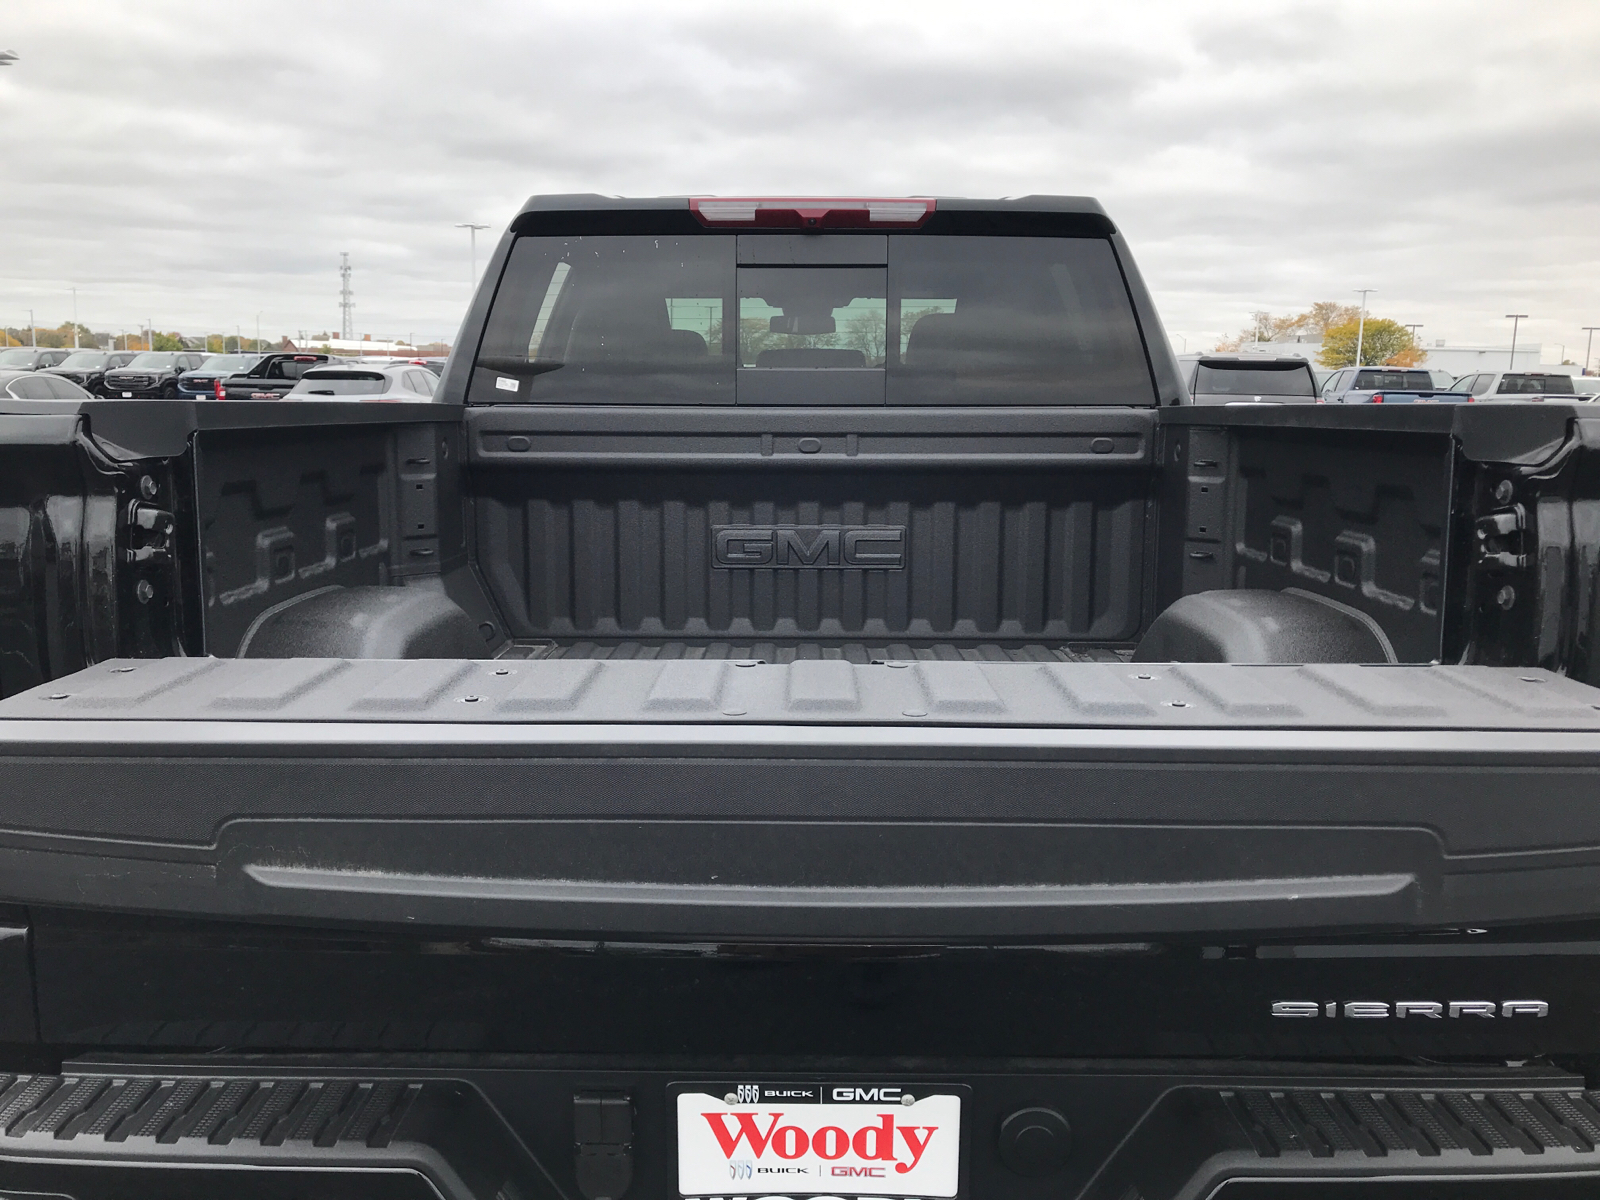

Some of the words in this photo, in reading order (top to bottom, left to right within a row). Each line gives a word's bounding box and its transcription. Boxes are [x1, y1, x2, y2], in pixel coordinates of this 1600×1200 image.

[715, 529, 902, 565] GMC
[1271, 1000, 1549, 1019] SIERRA
[764, 1089, 814, 1098] BUICK
[832, 1087, 902, 1101] GMC
[700, 1112, 939, 1174] Woody
[757, 1166, 810, 1175] BUICK
[830, 1165, 887, 1178] GMC
